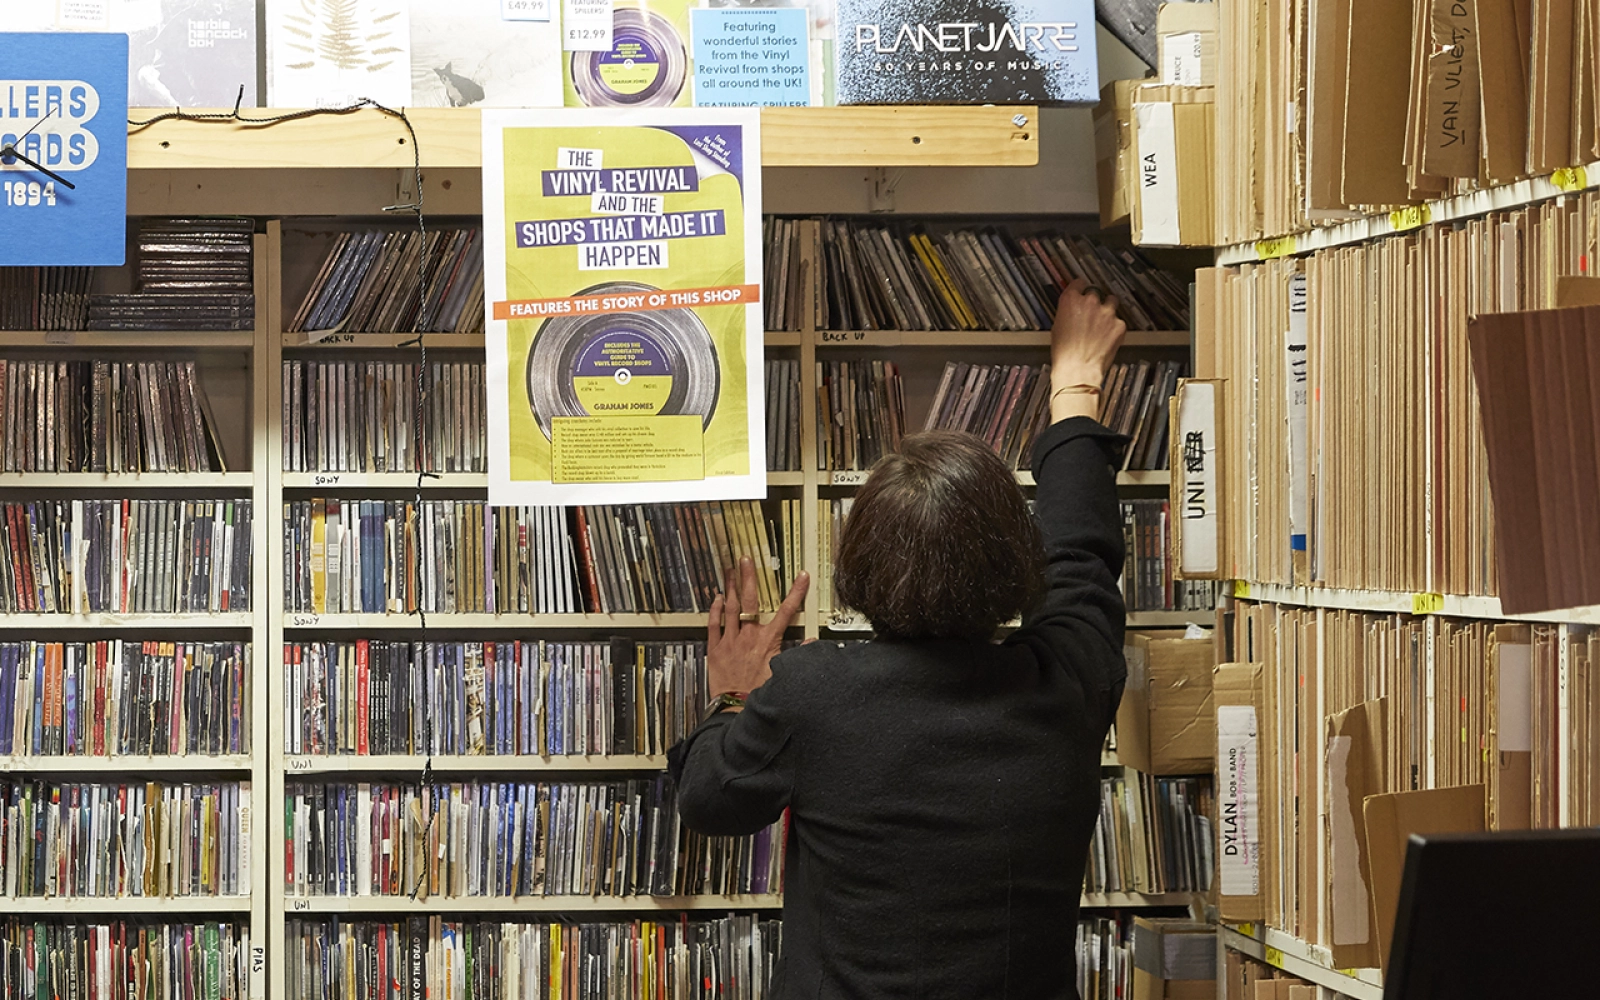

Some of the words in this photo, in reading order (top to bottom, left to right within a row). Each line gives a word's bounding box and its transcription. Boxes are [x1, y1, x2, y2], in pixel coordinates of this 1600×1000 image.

[188, 18, 231, 30] herbie
[723, 21, 776, 34] Featuring
[188, 28, 247, 40] hancock
[188, 37, 215, 48] box
[569, 29, 606, 40] £12.99
[702, 35, 760, 47] wonderful
[761, 35, 798, 47] stories
[855, 22, 978, 53] PLANET
[977, 22, 1078, 52] JARRE
[710, 49, 738, 61] from
[741, 49, 759, 61] the
[761, 49, 791, 61] Vinyl
[699, 64, 740, 75] Revival
[741, 64, 769, 75] from
[770, 64, 805, 75] shops
[875, 62, 895, 72] 50
[905, 62, 963, 72] YEARS
[975, 62, 997, 72] OF
[1007, 62, 1063, 72] MUSIC
[702, 77, 716, 88] all
[718, 77, 760, 88] around
[762, 77, 780, 88] the
[783, 77, 802, 88] UK!
[1439, 101, 1460, 148] VAN
[567, 150, 594, 167] THE
[1145, 152, 1158, 188] WEA
[550, 169, 607, 195] VINYL
[612, 168, 691, 193] REVIVAL
[4, 181, 57, 207] 1894
[597, 196, 627, 212] AND
[631, 197, 658, 213] THE
[522, 221, 586, 246] SHOPS
[590, 217, 639, 242] THAT
[640, 213, 695, 238] MADE
[699, 212, 719, 235] IT
[585, 245, 662, 267] HAPPEN
[509, 301, 572, 316] FEATURES
[574, 299, 600, 312] THE
[602, 296, 646, 310] STORY
[649, 294, 668, 306] OF
[670, 292, 700, 306] THIS
[703, 289, 742, 303] SHOP
[593, 403, 629, 411] GRAHAM
[630, 402, 654, 410] JONES
[1186, 480, 1206, 520] UNI
[1229, 748, 1237, 772] BAND
[1229, 780, 1237, 798] BOB
[242, 807, 250, 834] QUEEN
[252, 947, 264, 973] PIAS
[412, 960, 420, 976] THE
